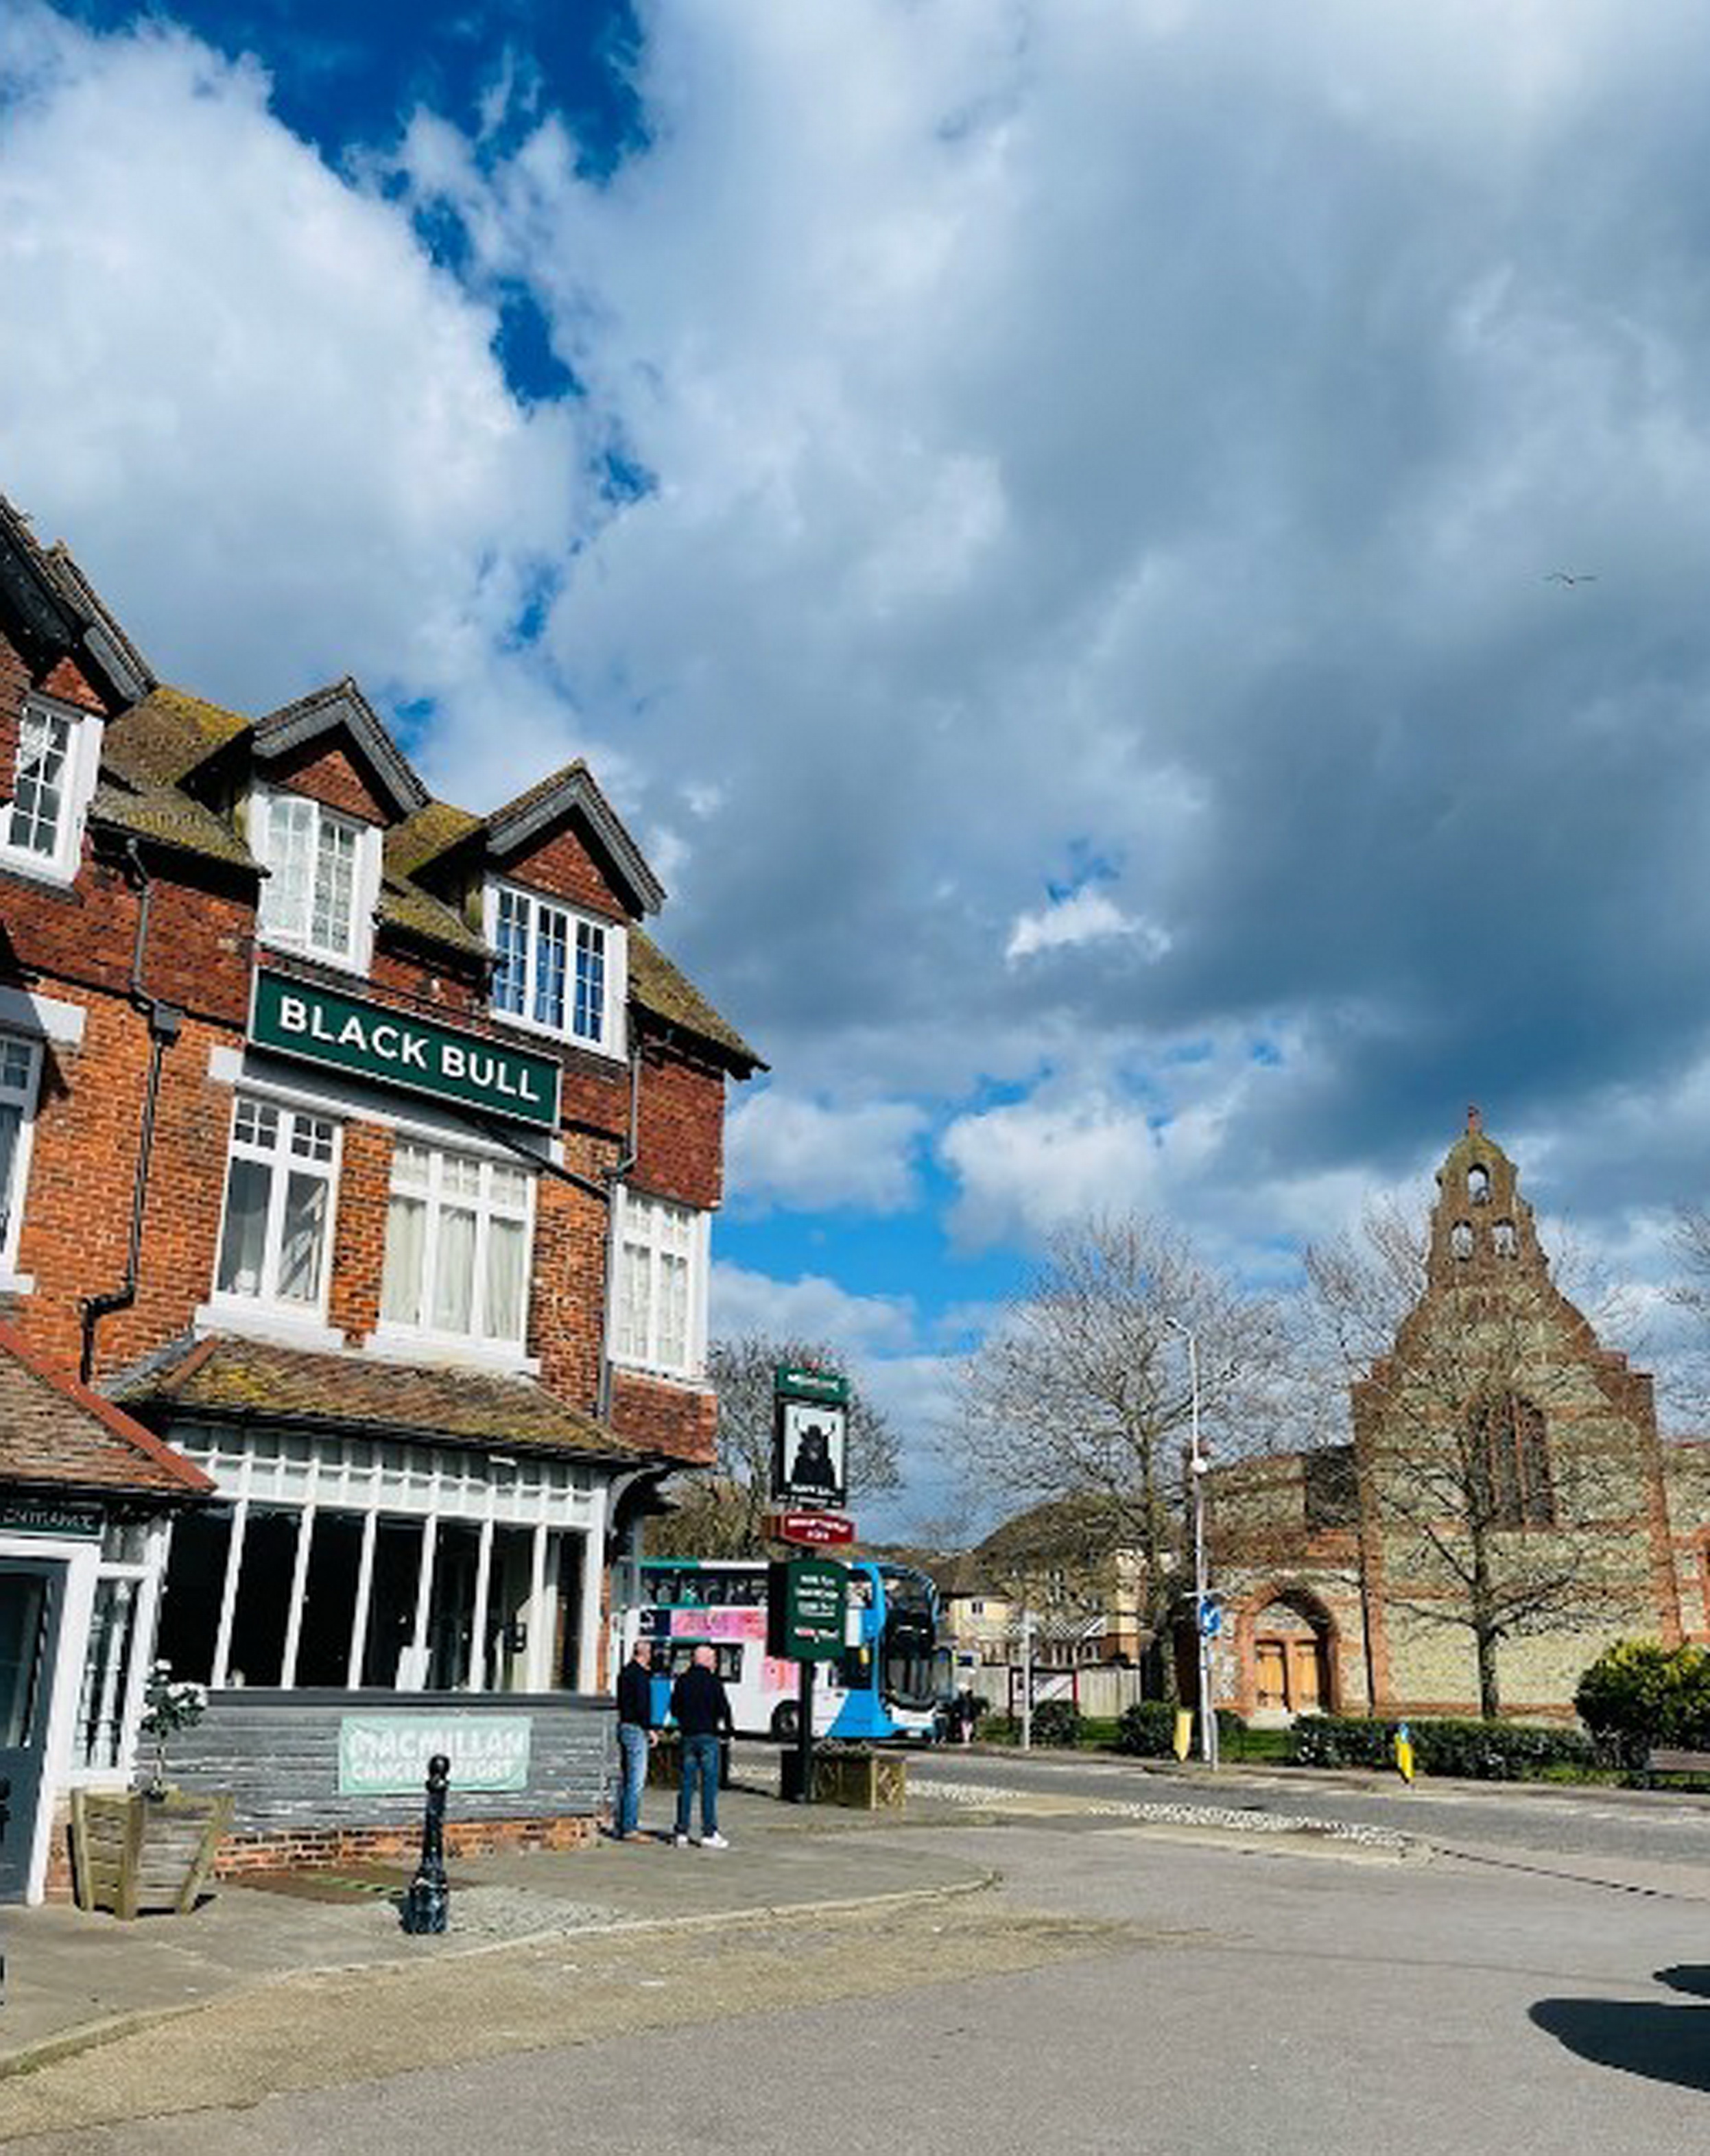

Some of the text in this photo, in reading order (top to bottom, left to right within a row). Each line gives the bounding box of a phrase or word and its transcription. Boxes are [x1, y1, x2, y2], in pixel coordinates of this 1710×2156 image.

[279, 995, 541, 1102] BLACK BULL
[348, 1729, 524, 1759] MACMILLAN
